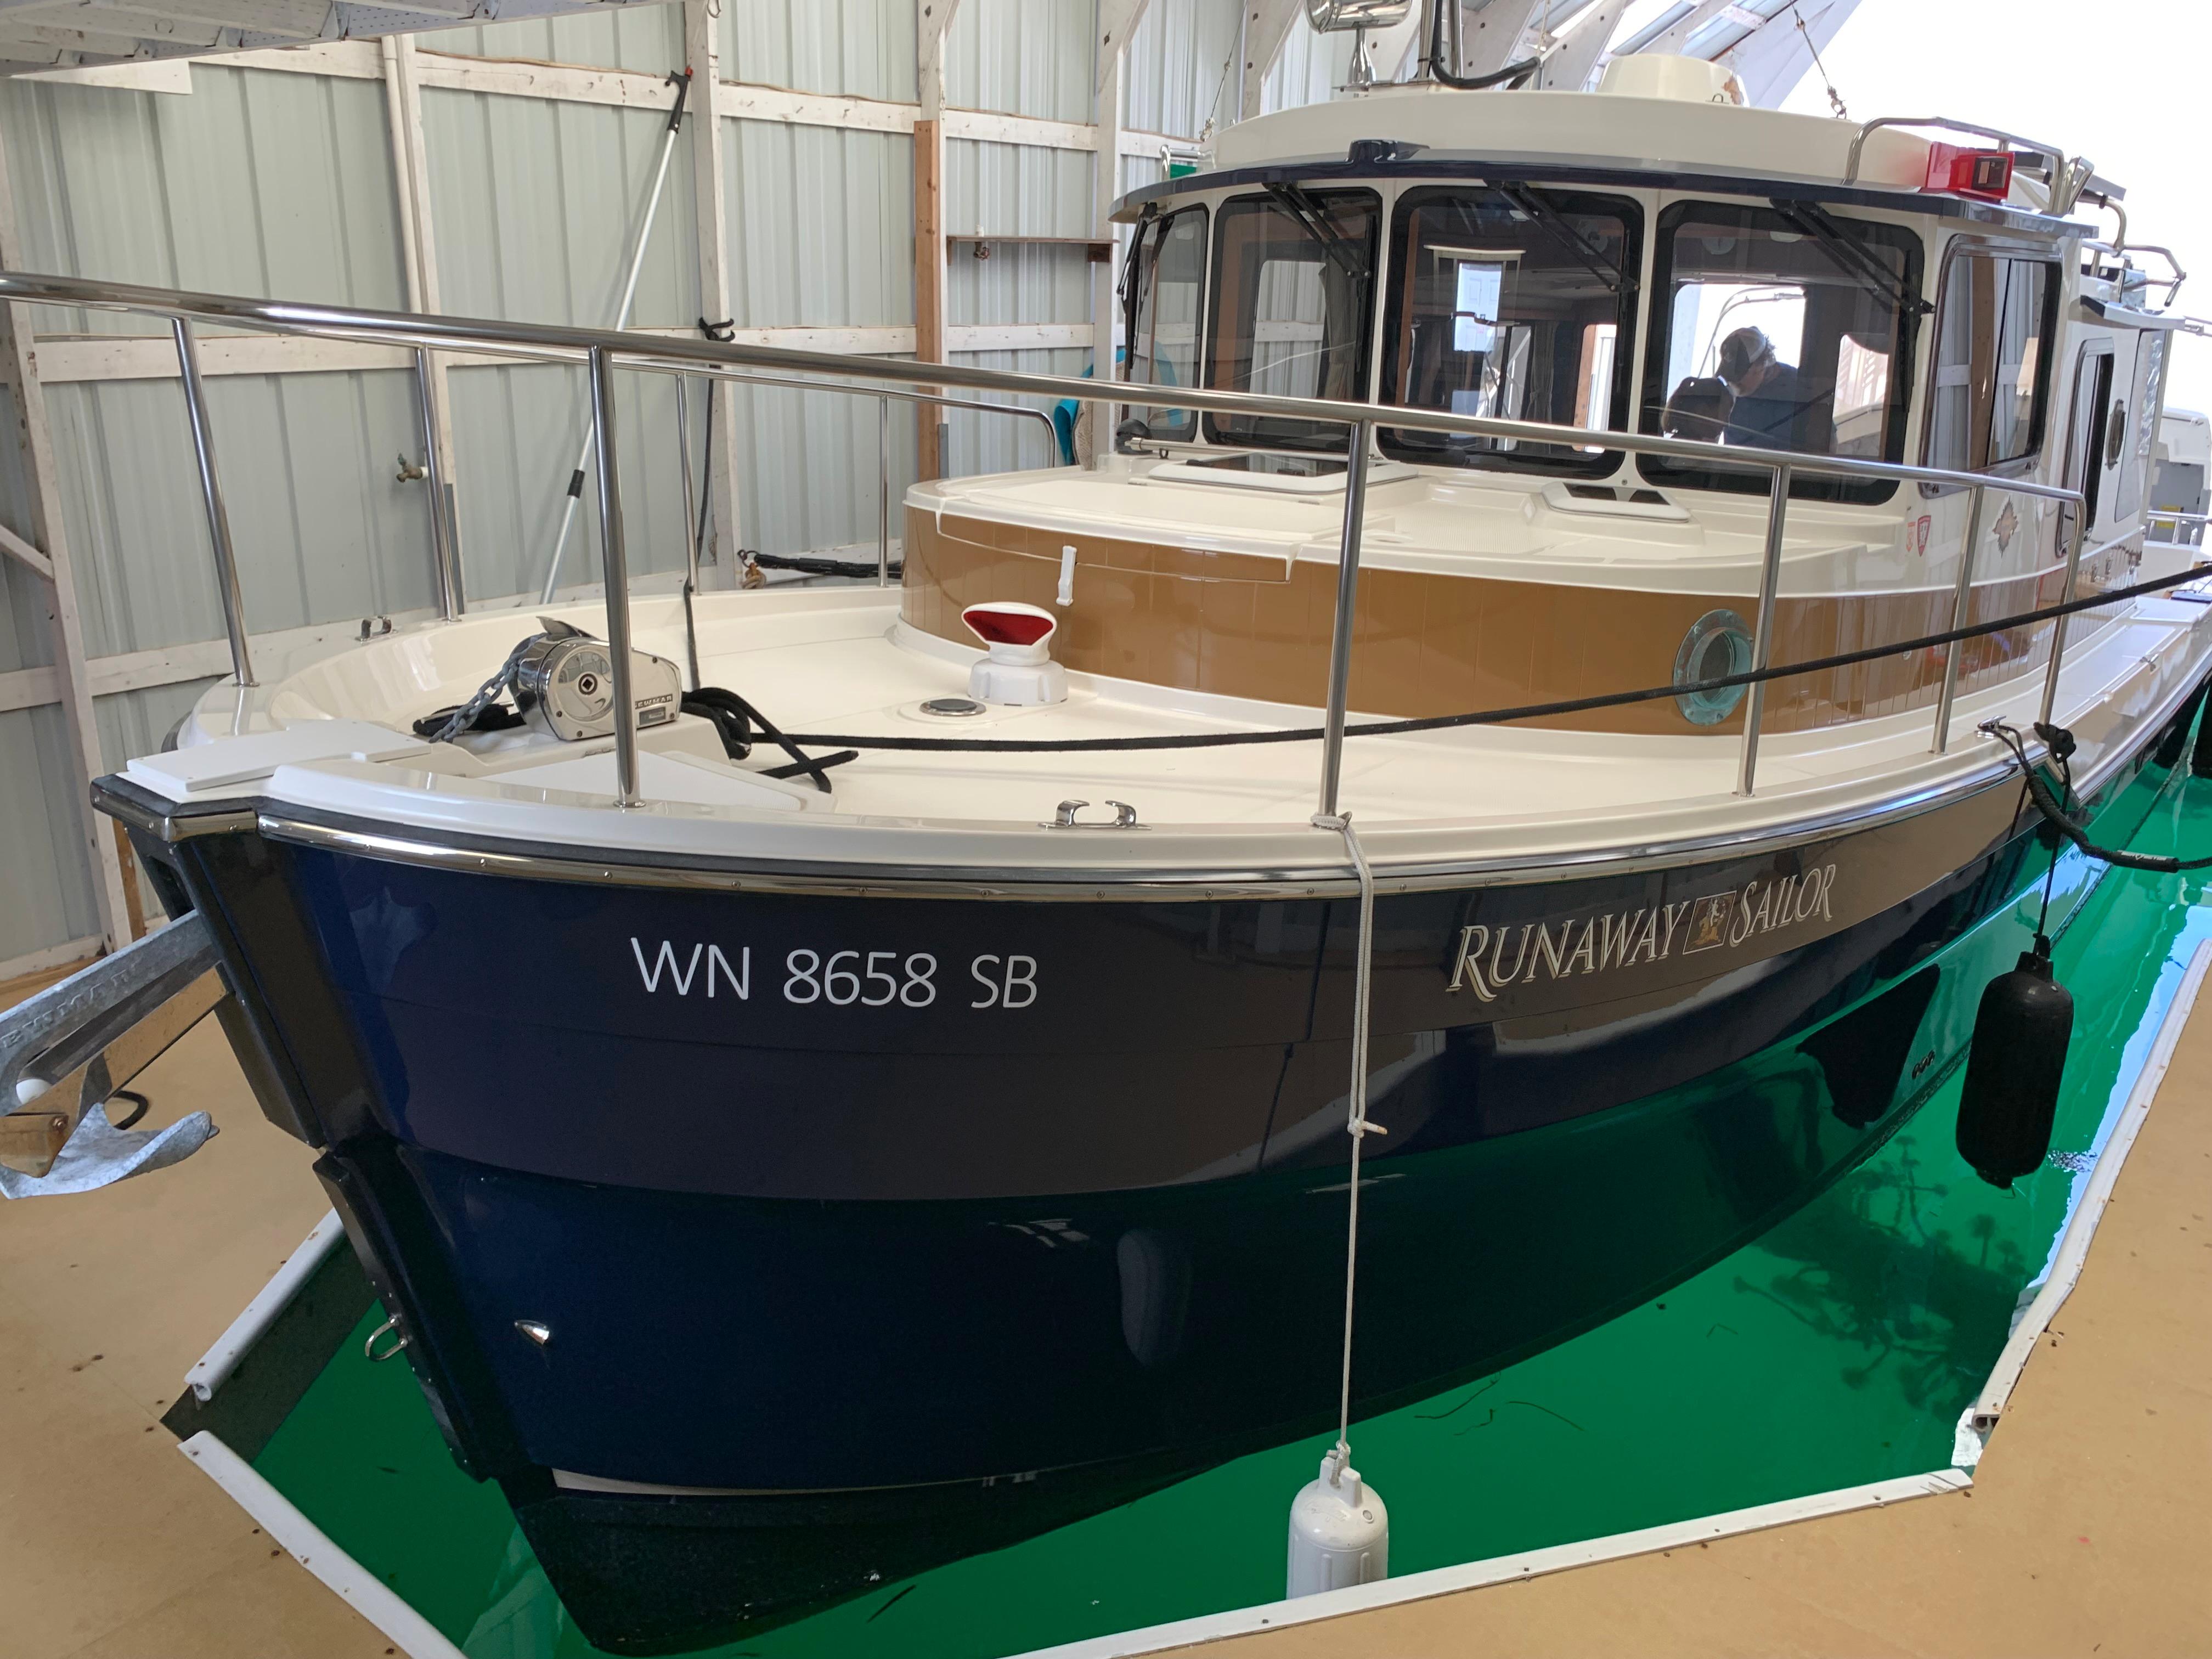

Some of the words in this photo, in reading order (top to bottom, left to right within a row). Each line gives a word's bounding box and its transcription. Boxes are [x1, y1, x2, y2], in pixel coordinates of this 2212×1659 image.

[635, 695, 673, 709] EWMAR
[1445, 900, 1690, 1002] RUNAWAY
[1729, 864, 1837, 947] SAILOR
[631, 937, 749, 1000] WN
[783, 949, 937, 1007] 8658
[970, 955, 1037, 1008] SB
